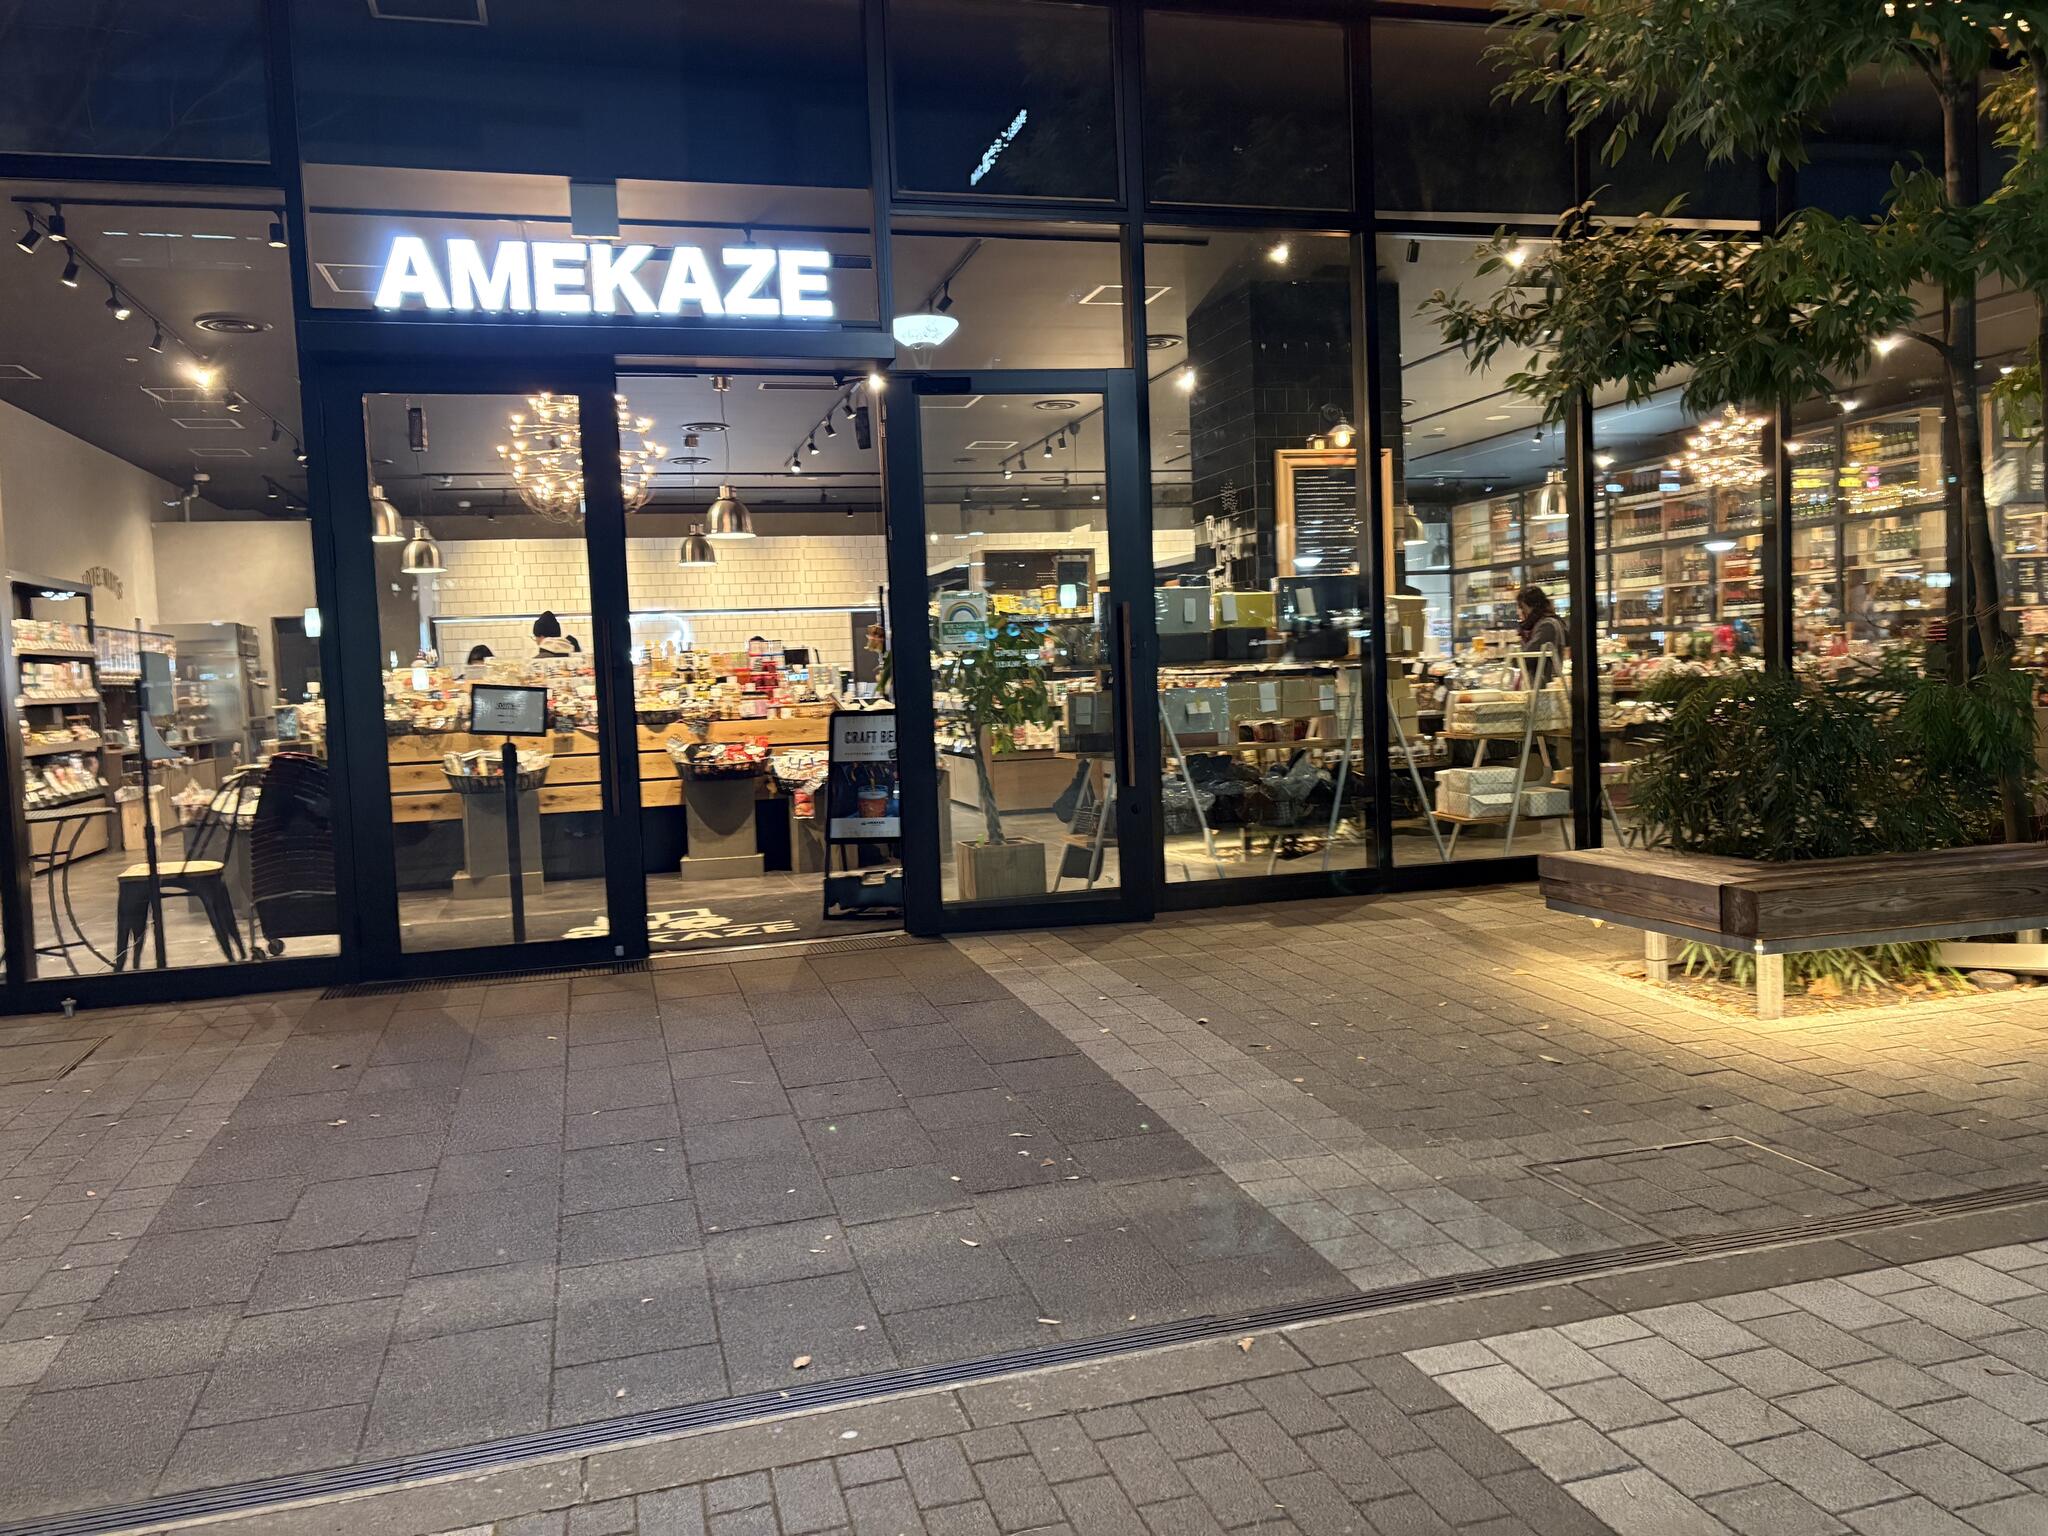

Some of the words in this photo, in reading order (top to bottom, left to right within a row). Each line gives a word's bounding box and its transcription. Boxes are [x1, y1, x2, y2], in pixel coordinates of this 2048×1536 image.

[374, 236, 834, 317] AMEKAZE
[844, 731, 877, 744] CRAFT
[880, 730, 896, 743] BE
